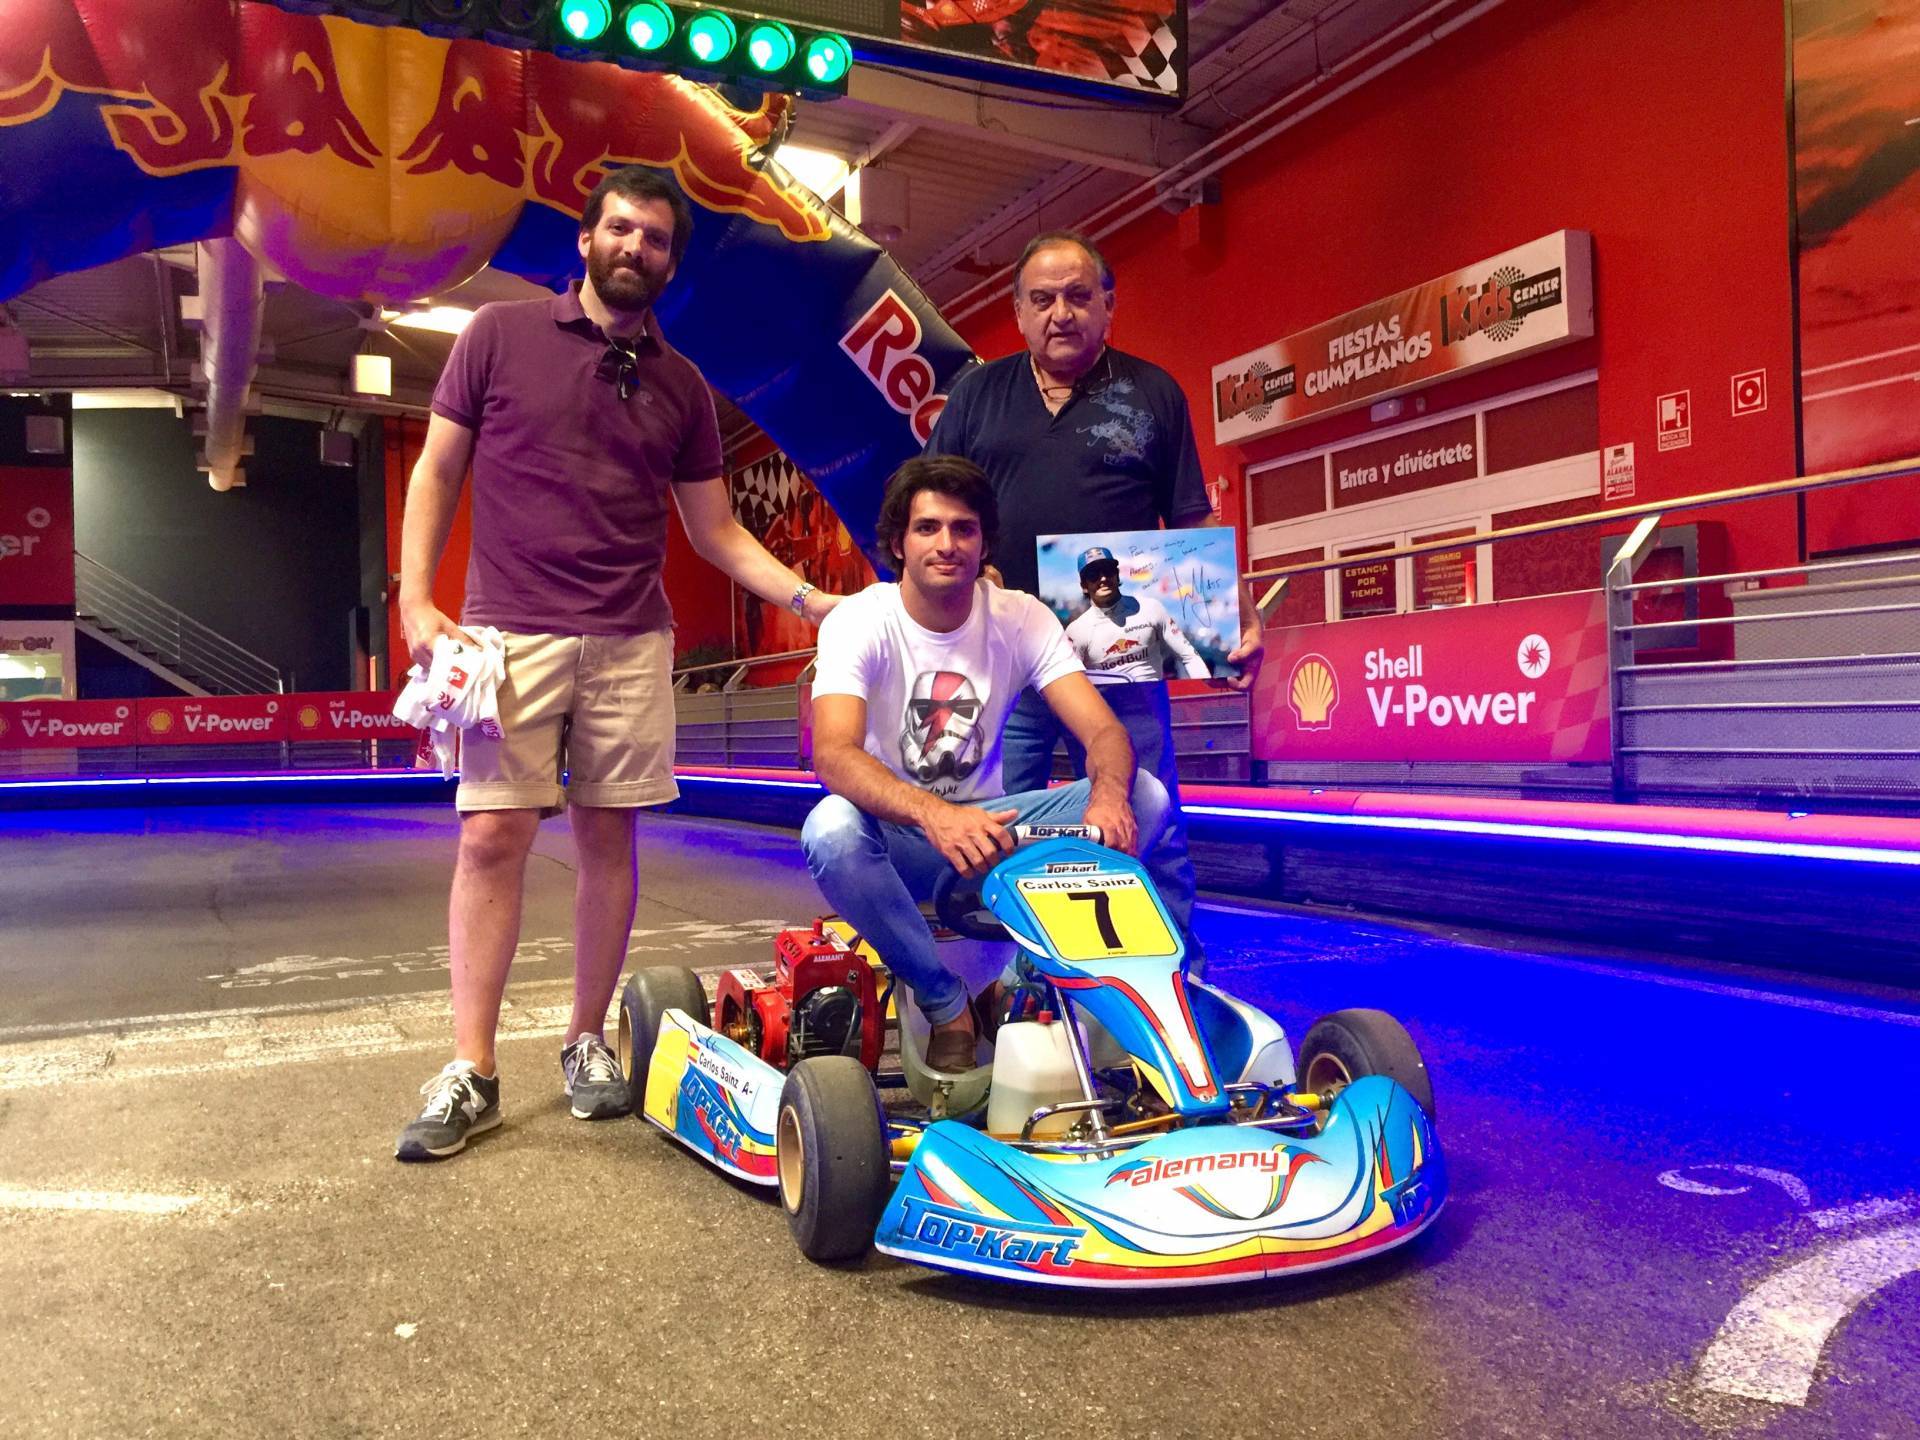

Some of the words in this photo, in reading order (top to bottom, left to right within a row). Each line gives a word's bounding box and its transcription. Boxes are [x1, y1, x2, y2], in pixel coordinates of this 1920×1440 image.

[1513, 277, 1560, 303] CENTER
[1442, 279, 1512, 346] Kids
[1328, 315, 1401, 363] FIESTAS
[1304, 331, 1433, 397] CUMPLEAÑOS
[1217, 370, 1264, 422] Kids
[1264, 371, 1295, 392] CENTER
[1339, 466, 1378, 490] Entra
[1382, 463, 1391, 484] y
[1394, 443, 1473, 477] diviértete
[1345, 564, 1388, 577] ESTANCIA
[1357, 577, 1376, 586] POR
[1350, 587, 1384, 598] TIEMPO
[1101, 651, 1125, 671] Red
[1125, 647, 1149, 664] Bull
[1364, 645, 1423, 680] Shell
[1366, 685, 1536, 727] V-Power
[22, 719, 124, 737] V-Power
[184, 714, 274, 732] V-Power
[1023, 880, 1083, 890] Carlos
[1087, 876, 1137, 888] Sainz
[1067, 891, 1123, 949] 7
[813, 953, 845, 963] ALEMANY
[699, 1052, 720, 1077] Carlos
[720, 1066, 739, 1089] Sainz
[1131, 1152, 1279, 1187] alemany
